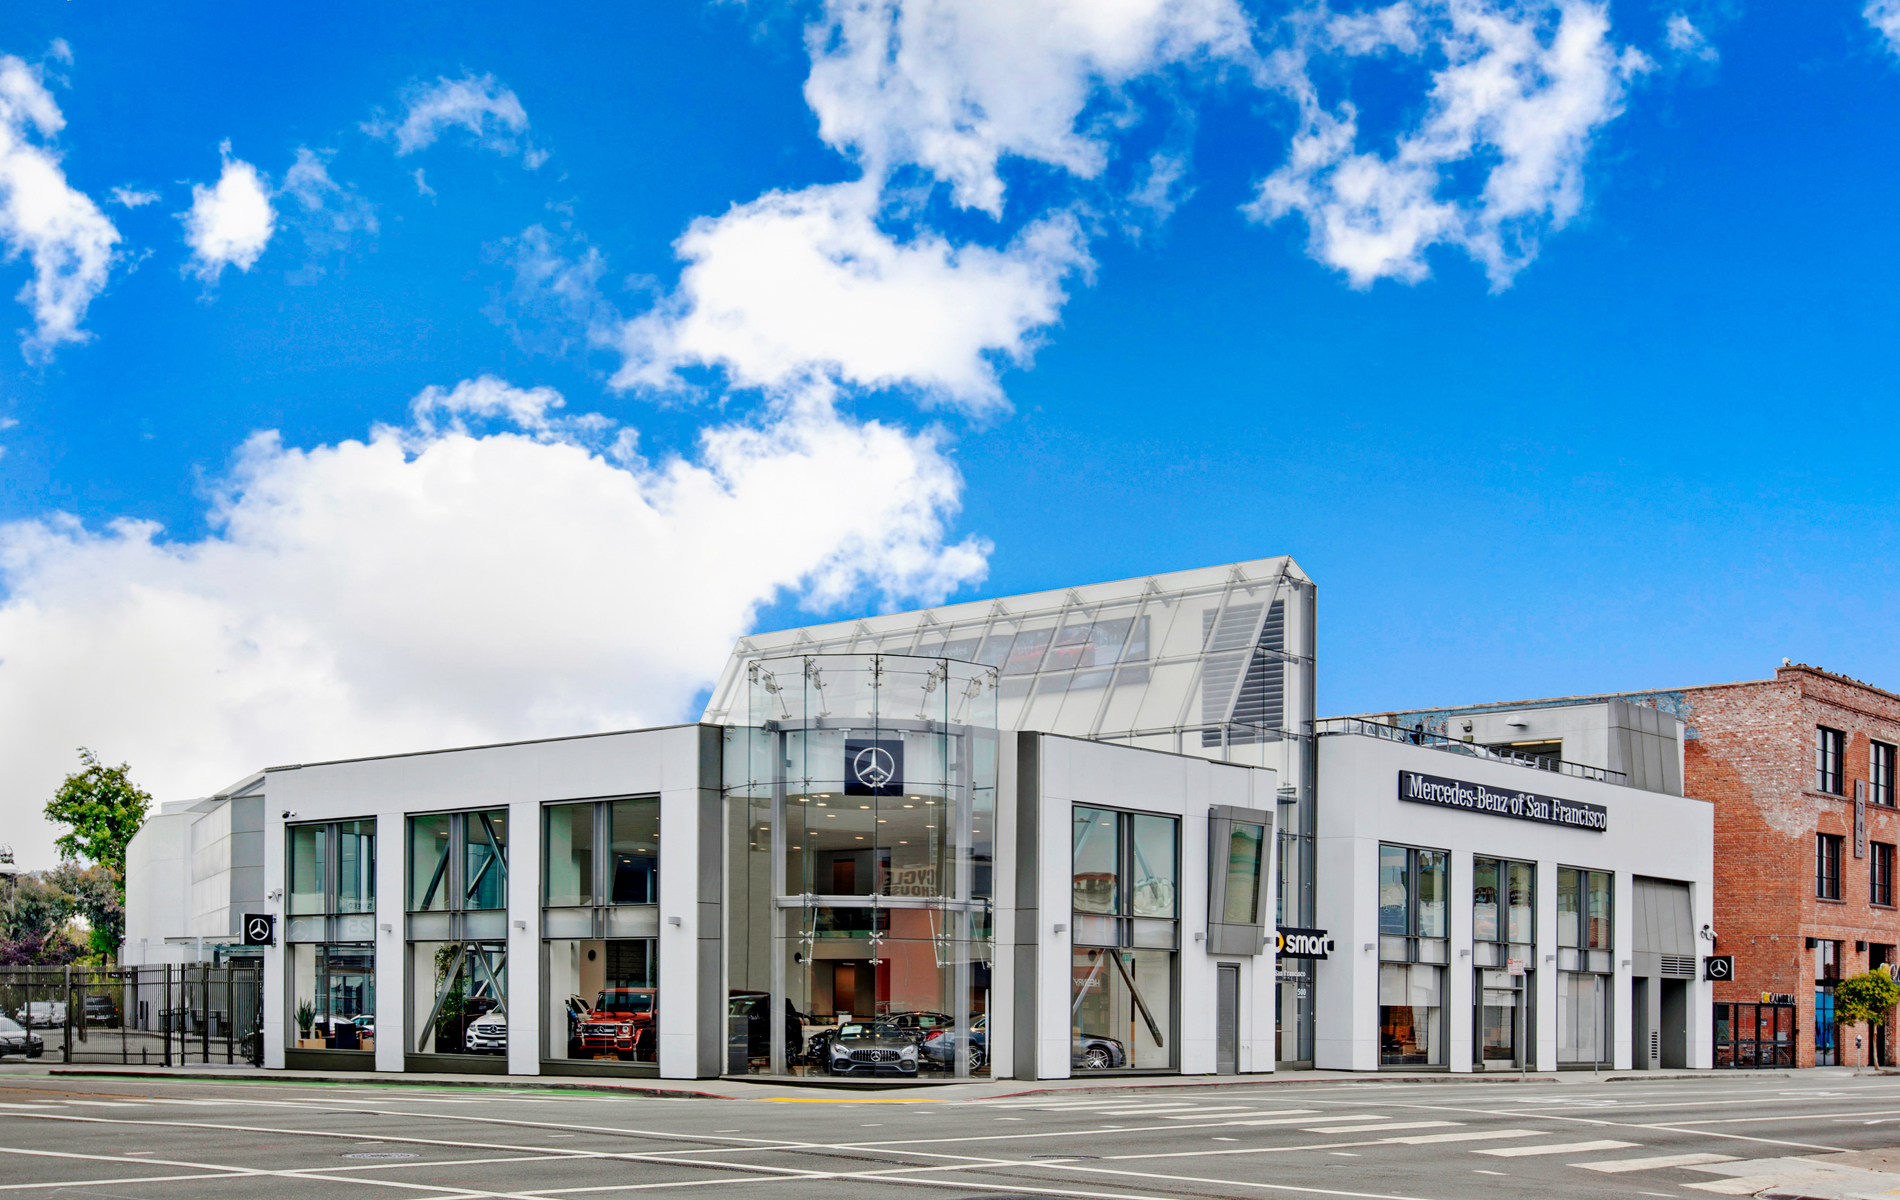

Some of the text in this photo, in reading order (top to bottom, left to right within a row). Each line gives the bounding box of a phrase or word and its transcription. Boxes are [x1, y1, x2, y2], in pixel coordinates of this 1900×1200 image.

[1409, 774, 1607, 829] Mercedes-Benz of San Francisco
[1285, 933, 1330, 956] smart
